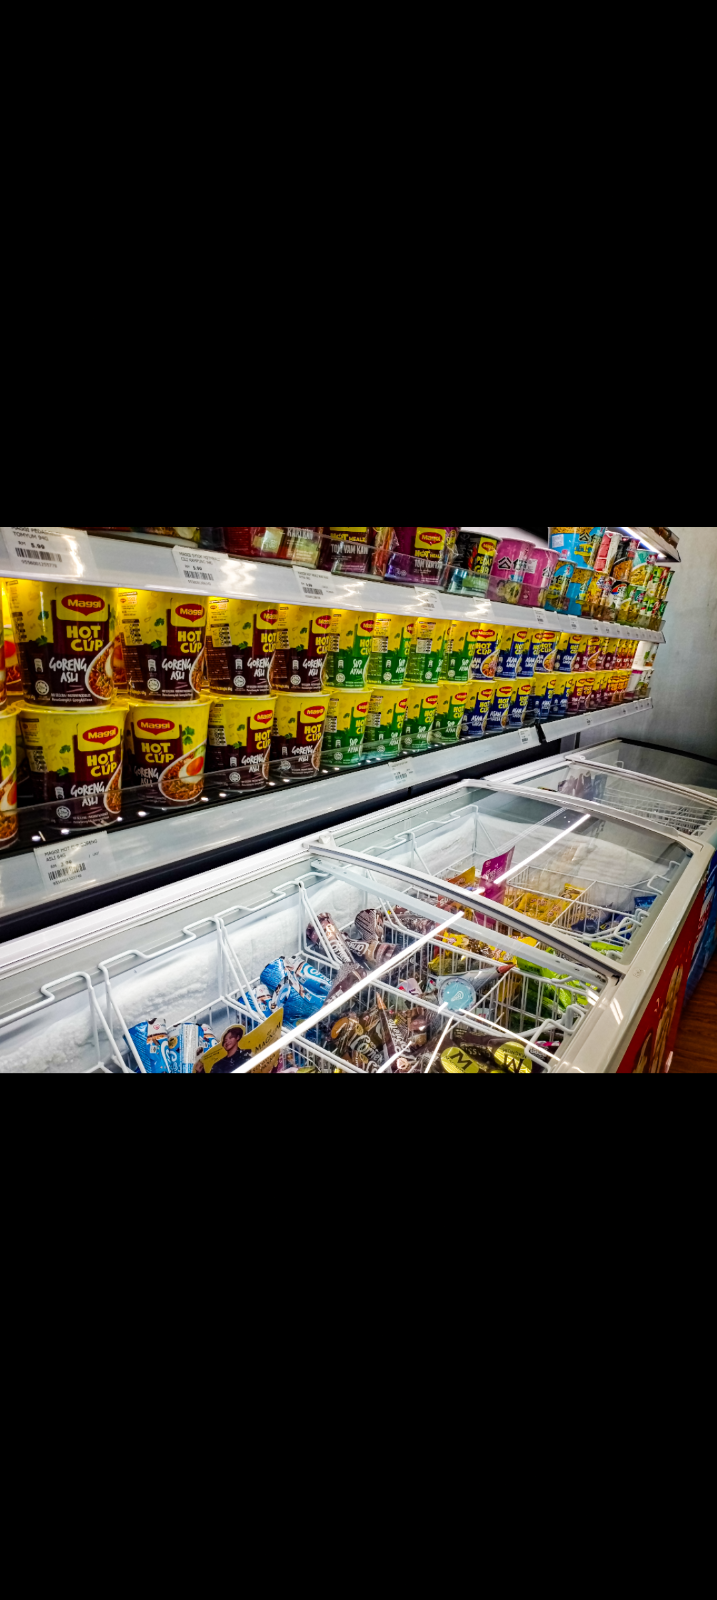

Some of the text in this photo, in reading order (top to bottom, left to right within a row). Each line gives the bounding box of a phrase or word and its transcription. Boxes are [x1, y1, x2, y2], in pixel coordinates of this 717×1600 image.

[67, 599, 102, 609] Maggi
[180, 607, 203, 616] Maggi
[66, 626, 101, 639] HOT
[177, 631, 202, 642] HOT
[49, 657, 87, 672] GORENG
[161, 658, 193, 672] GORENG
[60, 672, 78, 683] ASLI
[170, 671, 186, 680] ASLI
[140, 721, 170, 729] Maggi
[304, 724, 322, 734] HOT
[88, 728, 117, 740] Maggi
[141, 742, 171, 753] HOT
[86, 750, 116, 767] HOT
[70, 781, 106, 798] GORENG
[82, 796, 99, 807] ASLI
